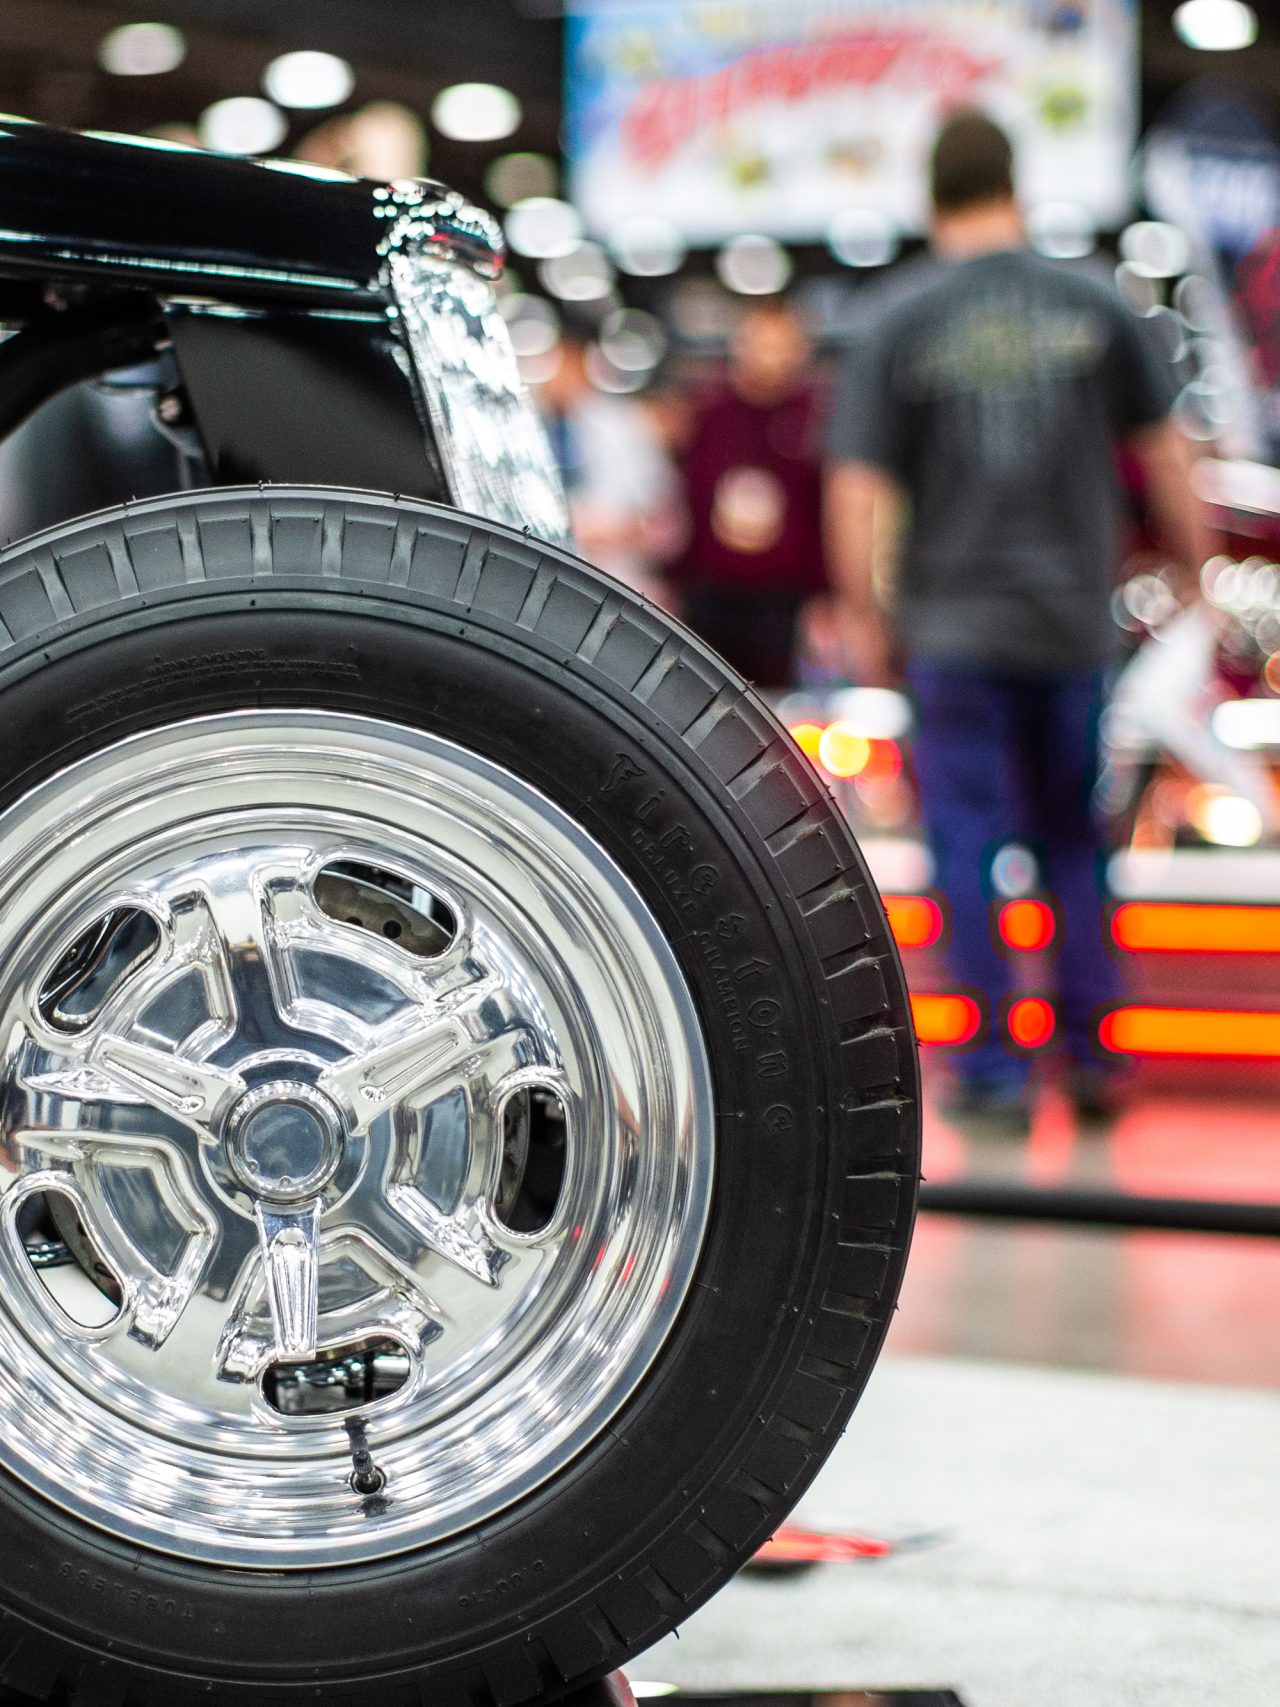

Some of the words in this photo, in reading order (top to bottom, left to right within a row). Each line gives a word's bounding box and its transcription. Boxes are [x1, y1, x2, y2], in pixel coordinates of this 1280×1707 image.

[599, 752, 794, 1134] Firestone
[631, 829, 698, 914] DELUXE
[697, 931, 750, 1051] CHAMPION
[57, 1560, 194, 1618] TUBELESS
